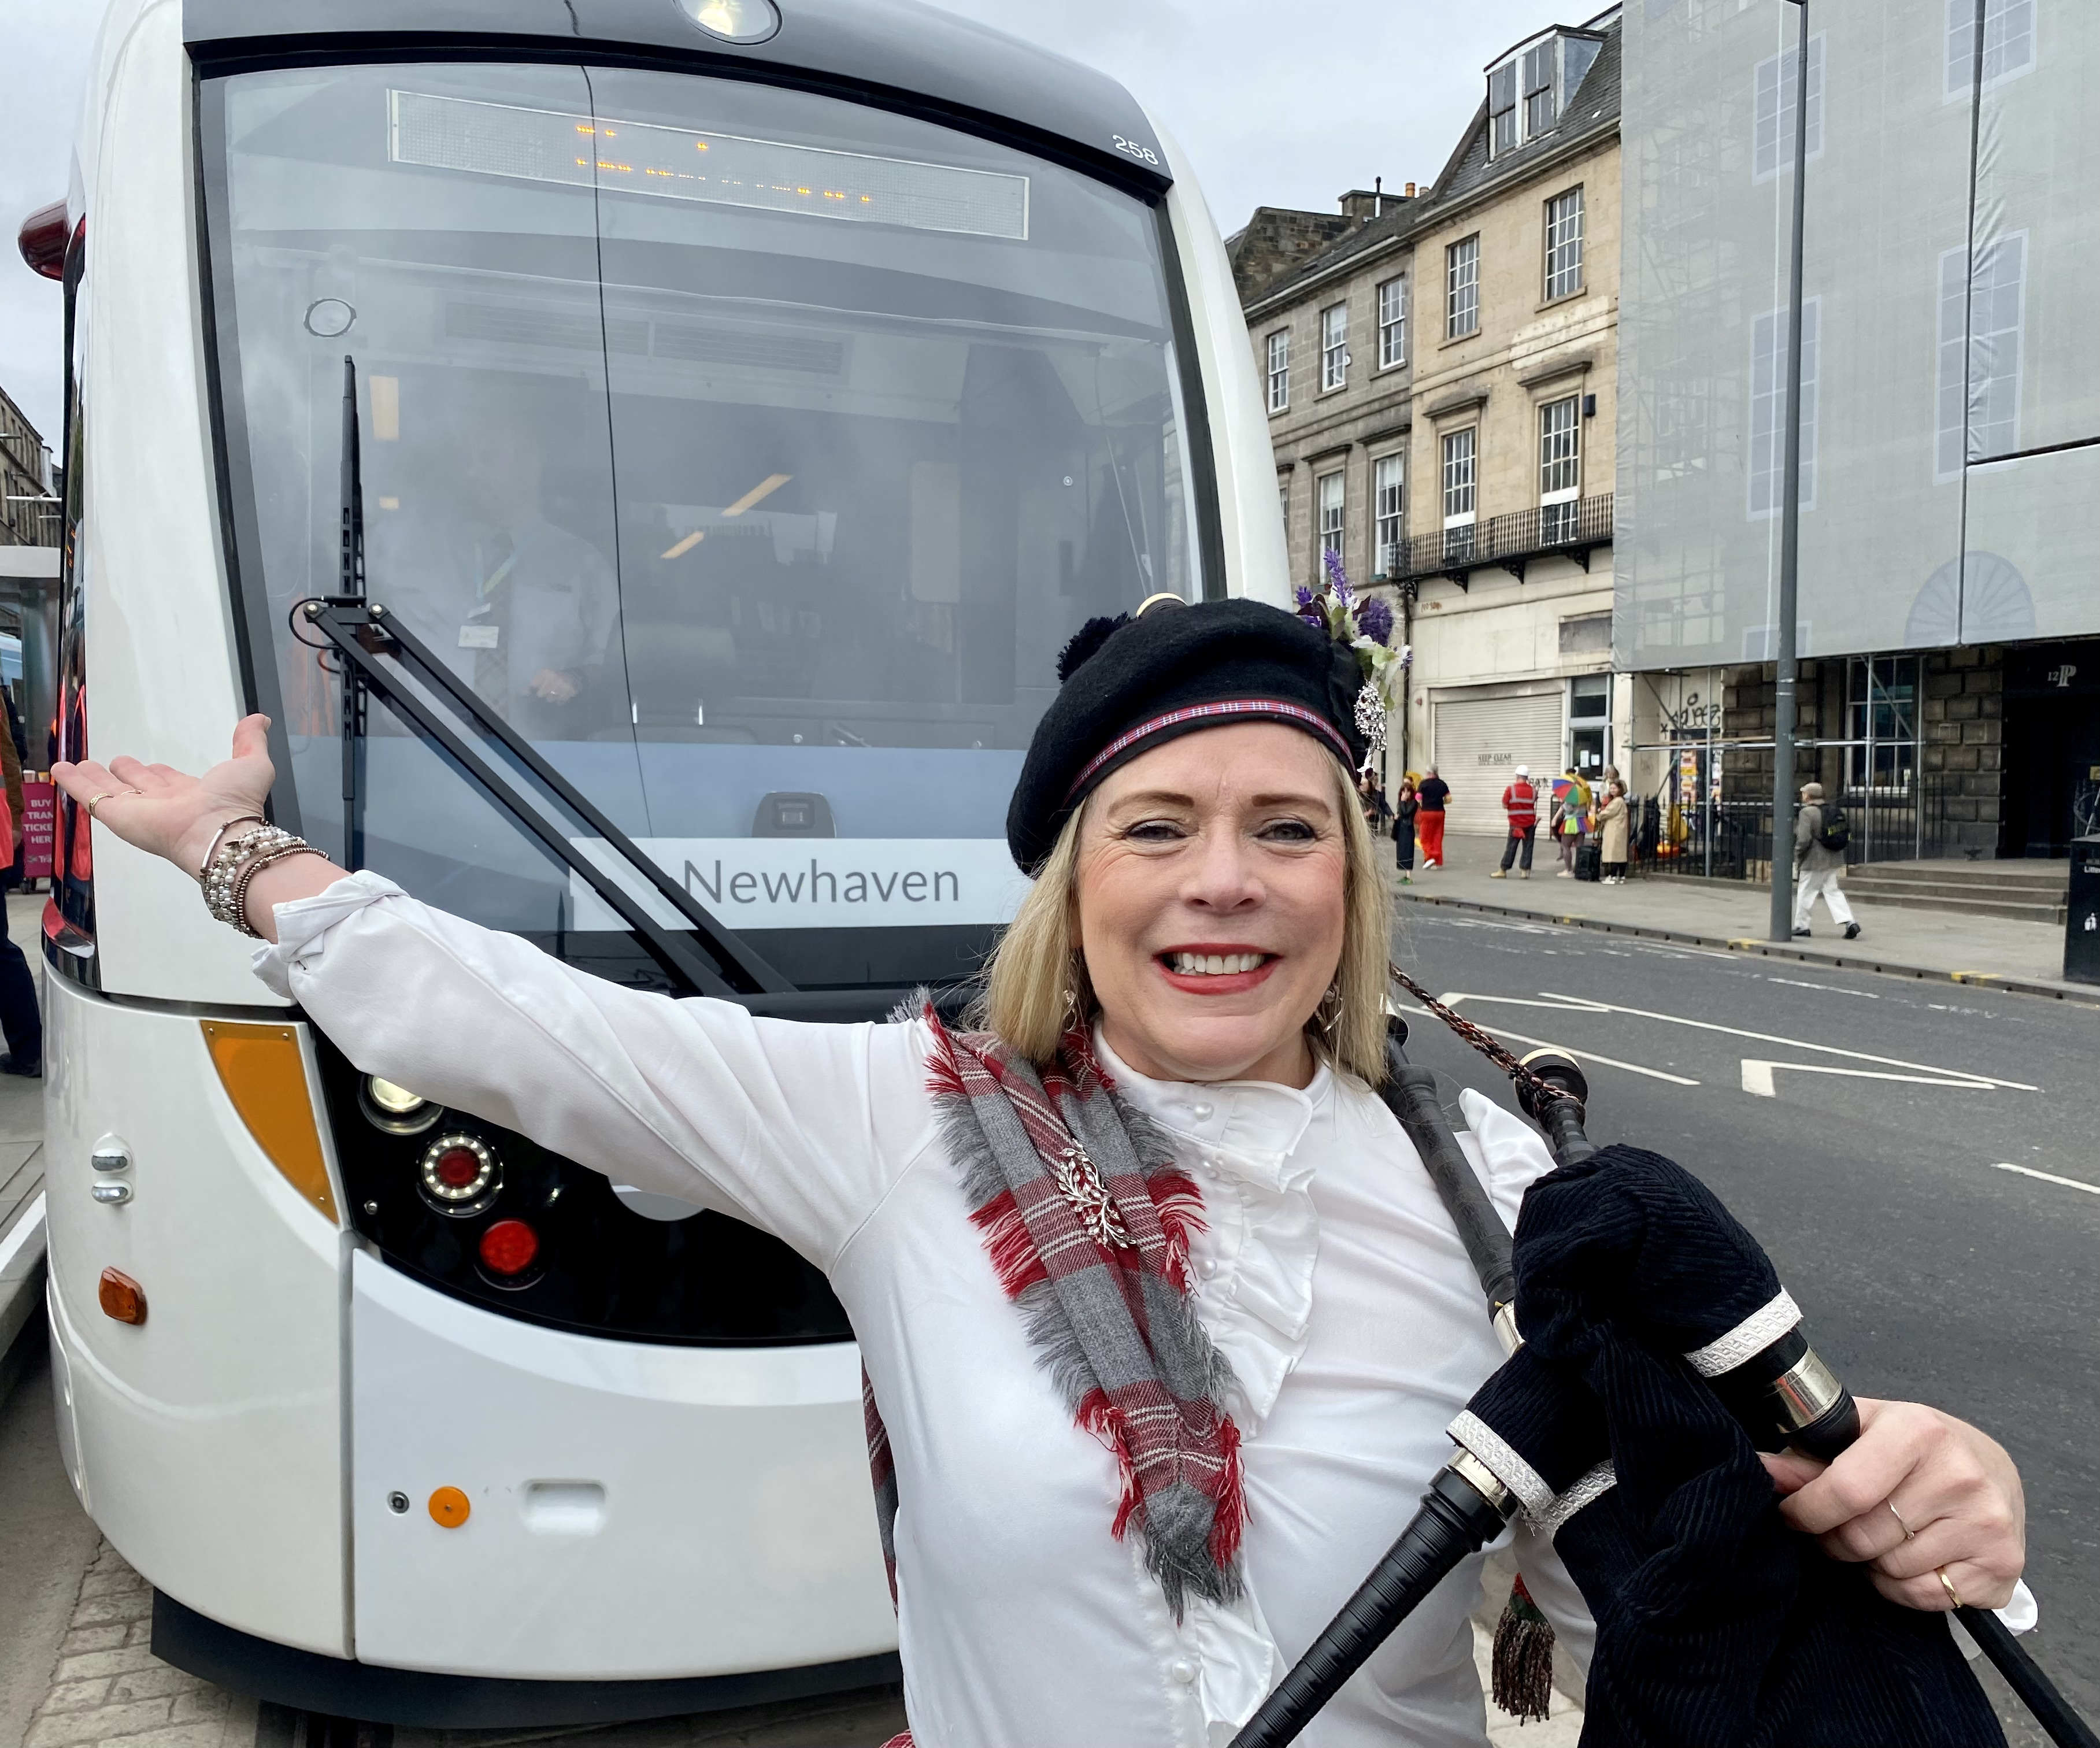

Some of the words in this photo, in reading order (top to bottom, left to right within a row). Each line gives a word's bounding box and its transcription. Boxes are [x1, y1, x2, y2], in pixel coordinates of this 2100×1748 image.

[1112, 134, 1159, 165] 258
[2047, 671, 2059, 682] 12
[1477, 753, 1492, 762] KEEP
[1494, 753, 1512, 762] CLEAR
[31, 799, 51, 808] BUY
[23, 823, 53, 832] TICKE
[31, 836, 52, 844] HER
[684, 858, 960, 904] Newhaven
